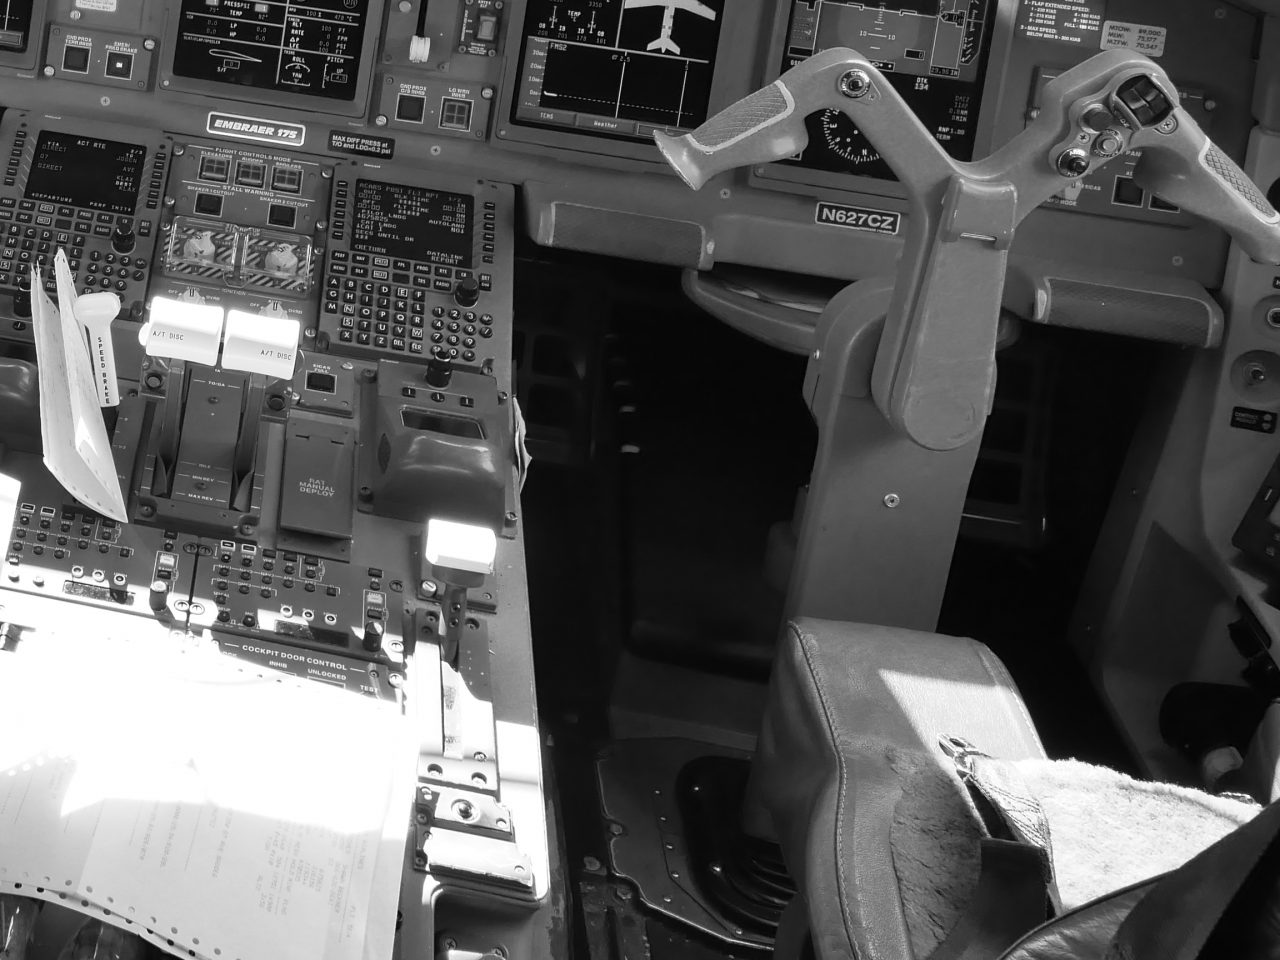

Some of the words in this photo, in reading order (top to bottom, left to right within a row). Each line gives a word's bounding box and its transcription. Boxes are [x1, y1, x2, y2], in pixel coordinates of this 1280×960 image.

[213, 118, 276, 136] EMBRAER
[276, 128, 298, 140] 175
[332, 134, 346, 142] MAX
[346, 136, 360, 144] DIFF
[360, 138, 382, 147] PRESS
[342, 142, 355, 150] and
[238, 151, 272, 160] CONTROLS
[244, 187, 275, 197] WARNING
[821, 208, 895, 230] N627CZ
[152, 330, 166, 338] A/T
[169, 332, 185, 341] DISC
[260, 349, 274, 358] A/T
[277, 352, 293, 361] DISC
[299, 481, 335, 492] MANUAL
[299, 486, 335, 497] DEPLOY
[242, 644, 279, 658] COCKPIT
[280, 651, 305, 662] DOOR
[306, 657, 347, 671] CONTROL
[269, 660, 288, 669] INHIB
[307, 668, 347, 681] UNLOCKED
[359, 684, 379, 692] TEST
